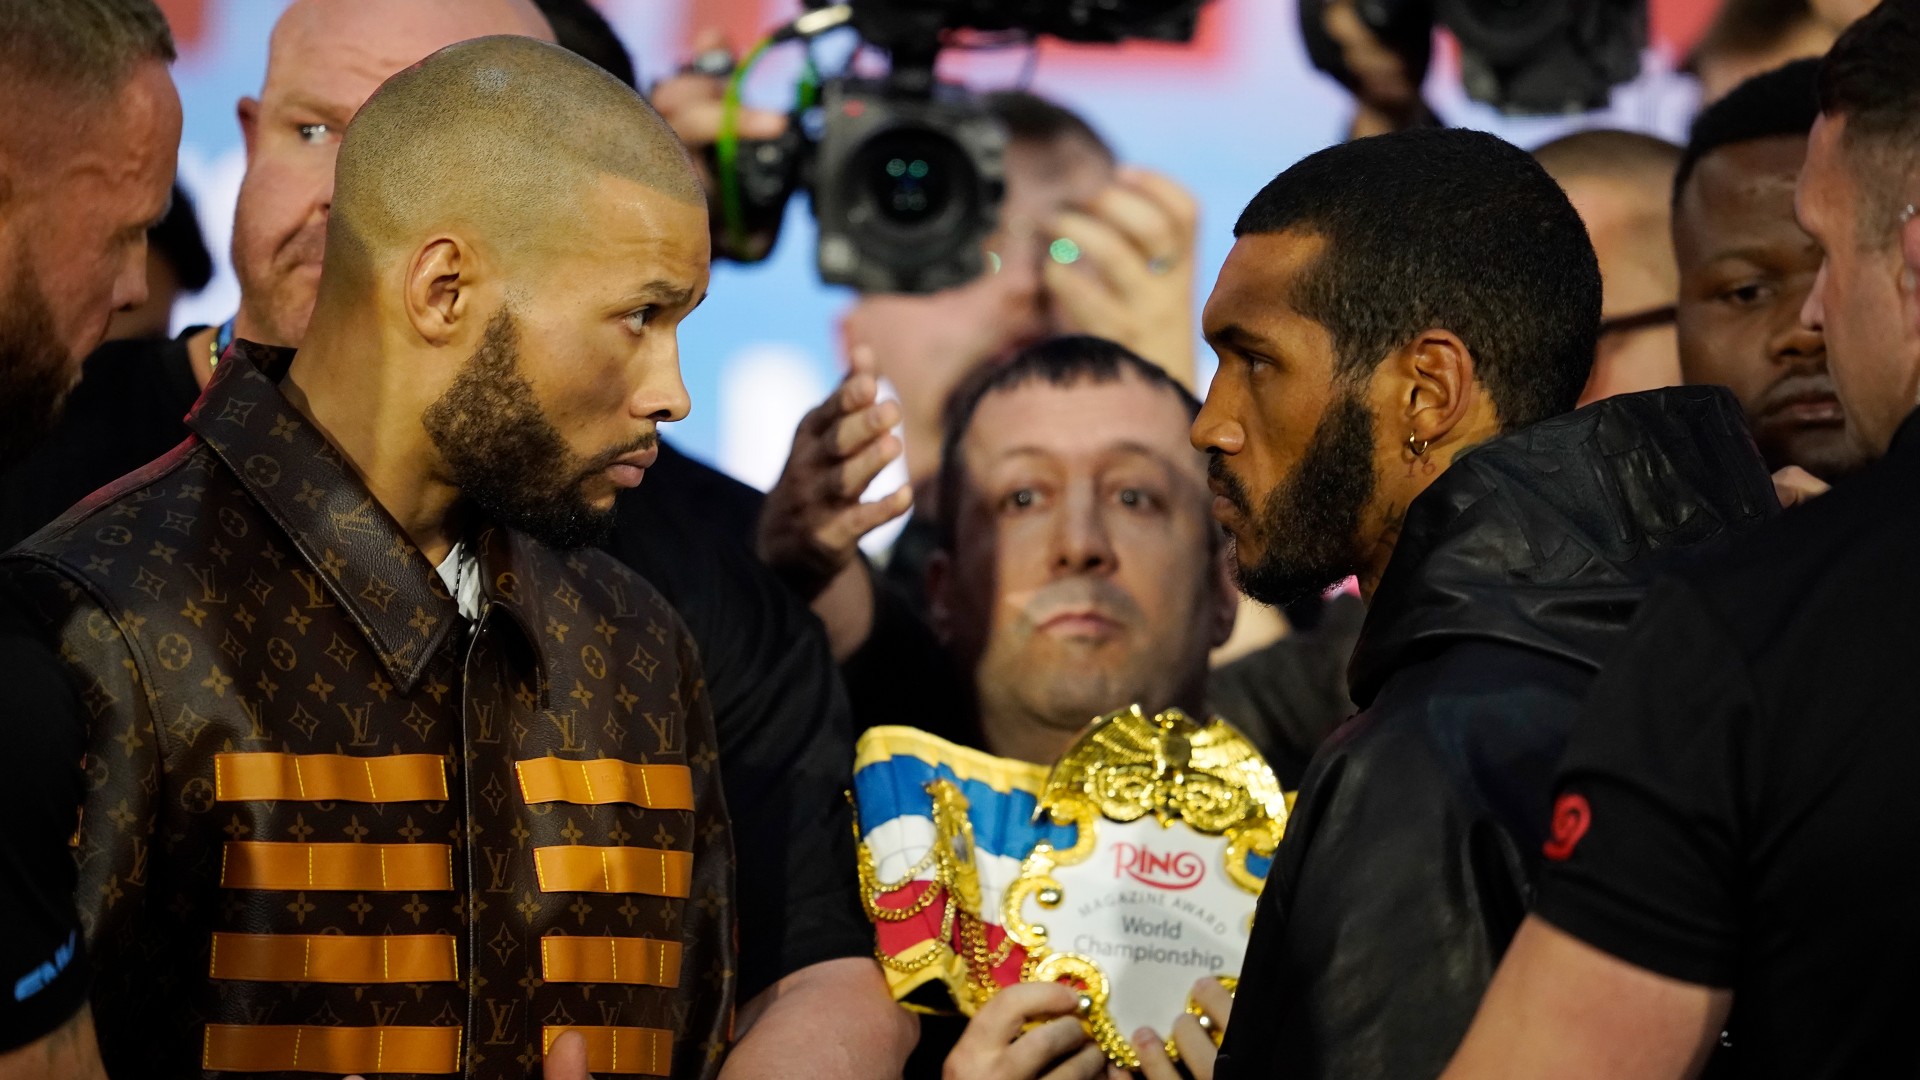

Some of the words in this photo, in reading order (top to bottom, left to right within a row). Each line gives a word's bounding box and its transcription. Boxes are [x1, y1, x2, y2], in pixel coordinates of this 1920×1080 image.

[1111, 841, 1207, 891] RING
[1077, 891, 1166, 918] MAGAZINE
[1172, 896, 1227, 936] AWARD
[1121, 915, 1183, 941] World
[1073, 933, 1225, 971] Championship
